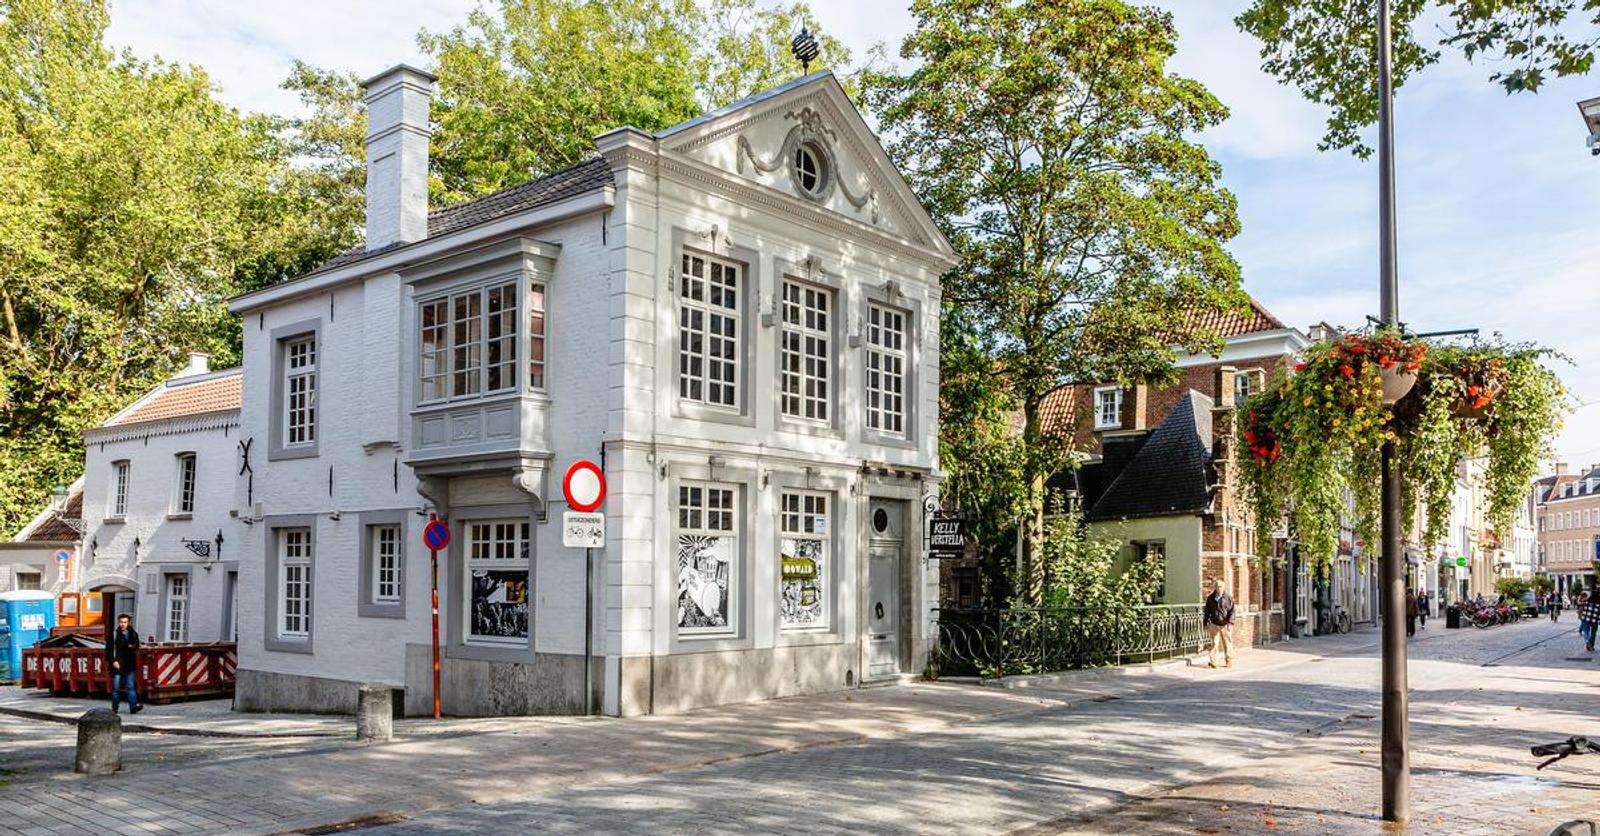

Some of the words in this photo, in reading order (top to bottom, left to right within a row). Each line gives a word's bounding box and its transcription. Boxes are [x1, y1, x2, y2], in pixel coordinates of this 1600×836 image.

[933, 521, 960, 534] KELLY
[930, 533, 964, 546] VERSTELLA
[27, 657, 38, 671] DE
